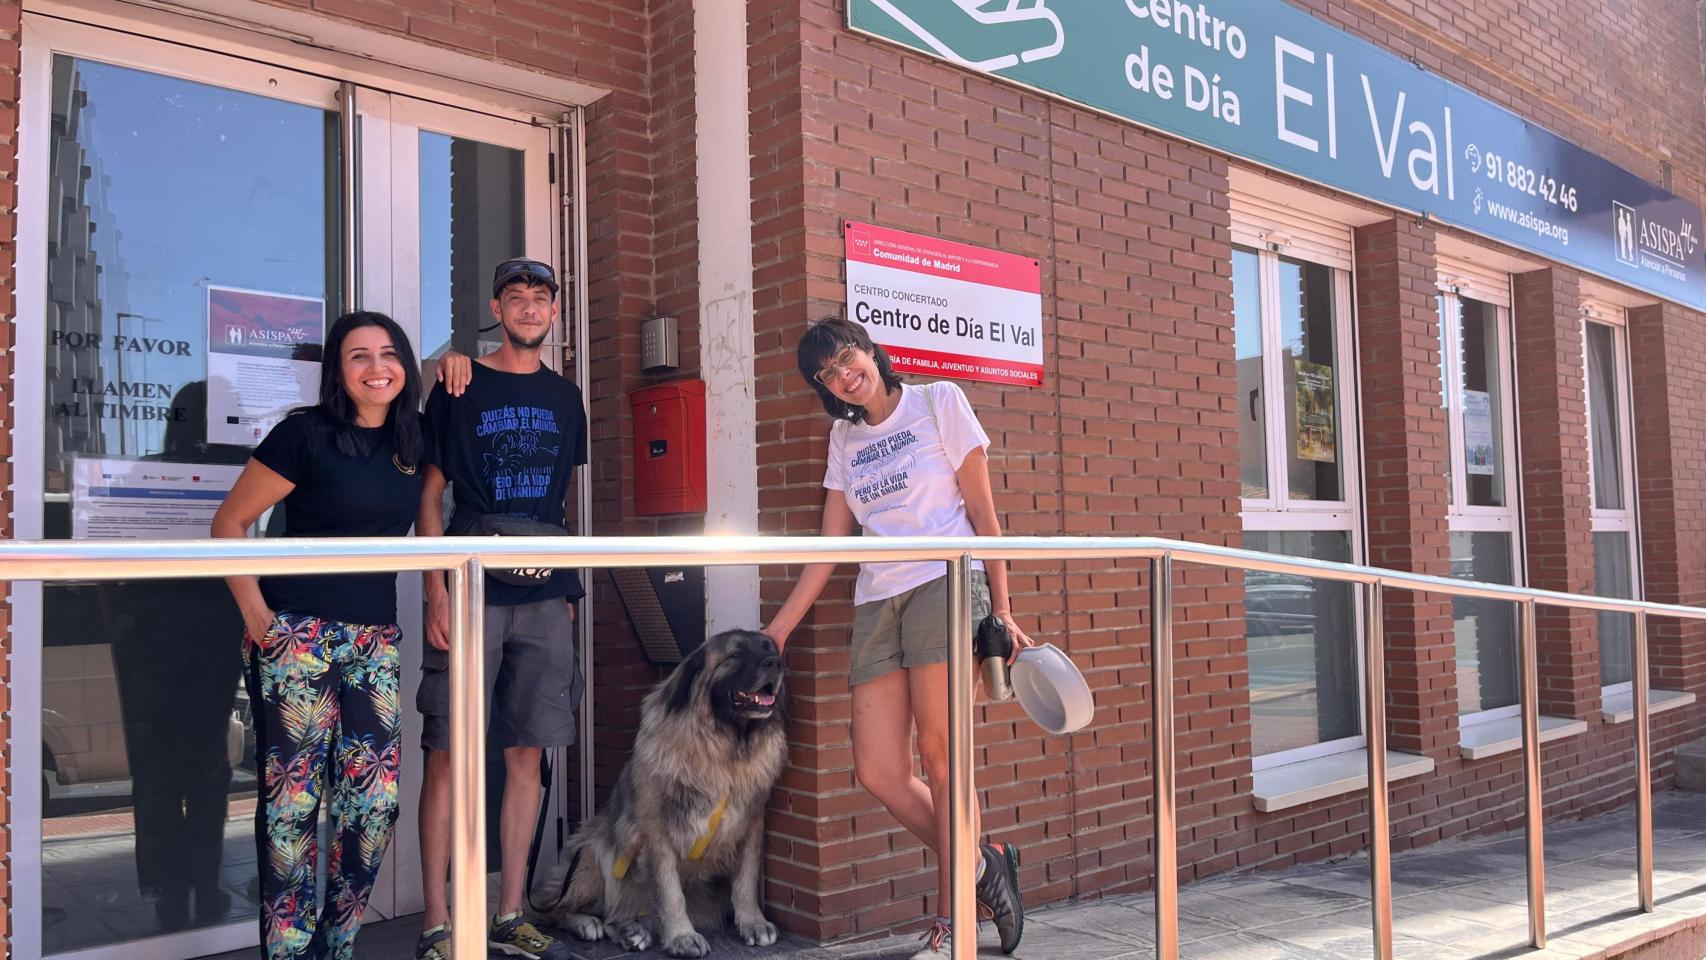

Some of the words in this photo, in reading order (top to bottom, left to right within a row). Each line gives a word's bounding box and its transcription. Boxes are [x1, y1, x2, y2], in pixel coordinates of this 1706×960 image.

[1125, 45, 1174, 100] de
[1184, 64, 1241, 126] Día
[1275, 35, 1337, 159] El
[1360, 73, 1455, 200] Val
[1485, 152, 1502, 183] 91
[1507, 160, 1537, 196] 882
[1539, 174, 1558, 204] 42
[1559, 183, 1578, 212] 46
[1487, 200, 1569, 246] www.asispa.org
[1640, 217, 1685, 261] ASISPA
[873, 248, 920, 265] Comunidad
[922, 257, 932, 267] de
[934, 259, 960, 272] Madrid
[854, 284, 890, 299] CENTRO
[891, 290, 948, 307] CONCERTADO
[249, 329, 292, 342] ASISPA
[855, 301, 922, 330] Centro
[928, 313, 950, 335] de
[956, 316, 984, 340] Día
[989, 321, 1005, 342] El
[1011, 324, 1035, 347] Val
[51, 330, 101, 349] POR
[113, 335, 192, 357] FAVOR
[902, 356, 911, 365] DE
[912, 358, 940, 369] FAMILIA,
[941, 362, 974, 373] JUVENTUD
[975, 366, 980, 374] Y
[981, 366, 1009, 376] ASUNTOS
[1009, 370, 1038, 380] SOCIALES
[72, 379, 172, 399] LLAMEN
[56, 402, 88, 418] AL
[94, 403, 187, 422] TIMBRE
[481, 405, 515, 423] QUIZÁS
[517, 406, 530, 418] NO
[531, 407, 554, 421] PUEDA
[476, 418, 519, 437] CAMBIAR
[521, 417, 530, 429] EL
[856, 442, 877, 459] QUIZÁS
[877, 439, 887, 450] NO
[887, 430, 913, 444] PUEDA
[851, 451, 880, 467] CAMBIAR
[880, 447, 890, 457] EL
[855, 485, 871, 498] PERO
[880, 478, 889, 488] LA
[890, 471, 908, 484] VIDA
[860, 495, 871, 504] DE
[871, 490, 881, 501] UN
[881, 481, 908, 497] ANIMAL
